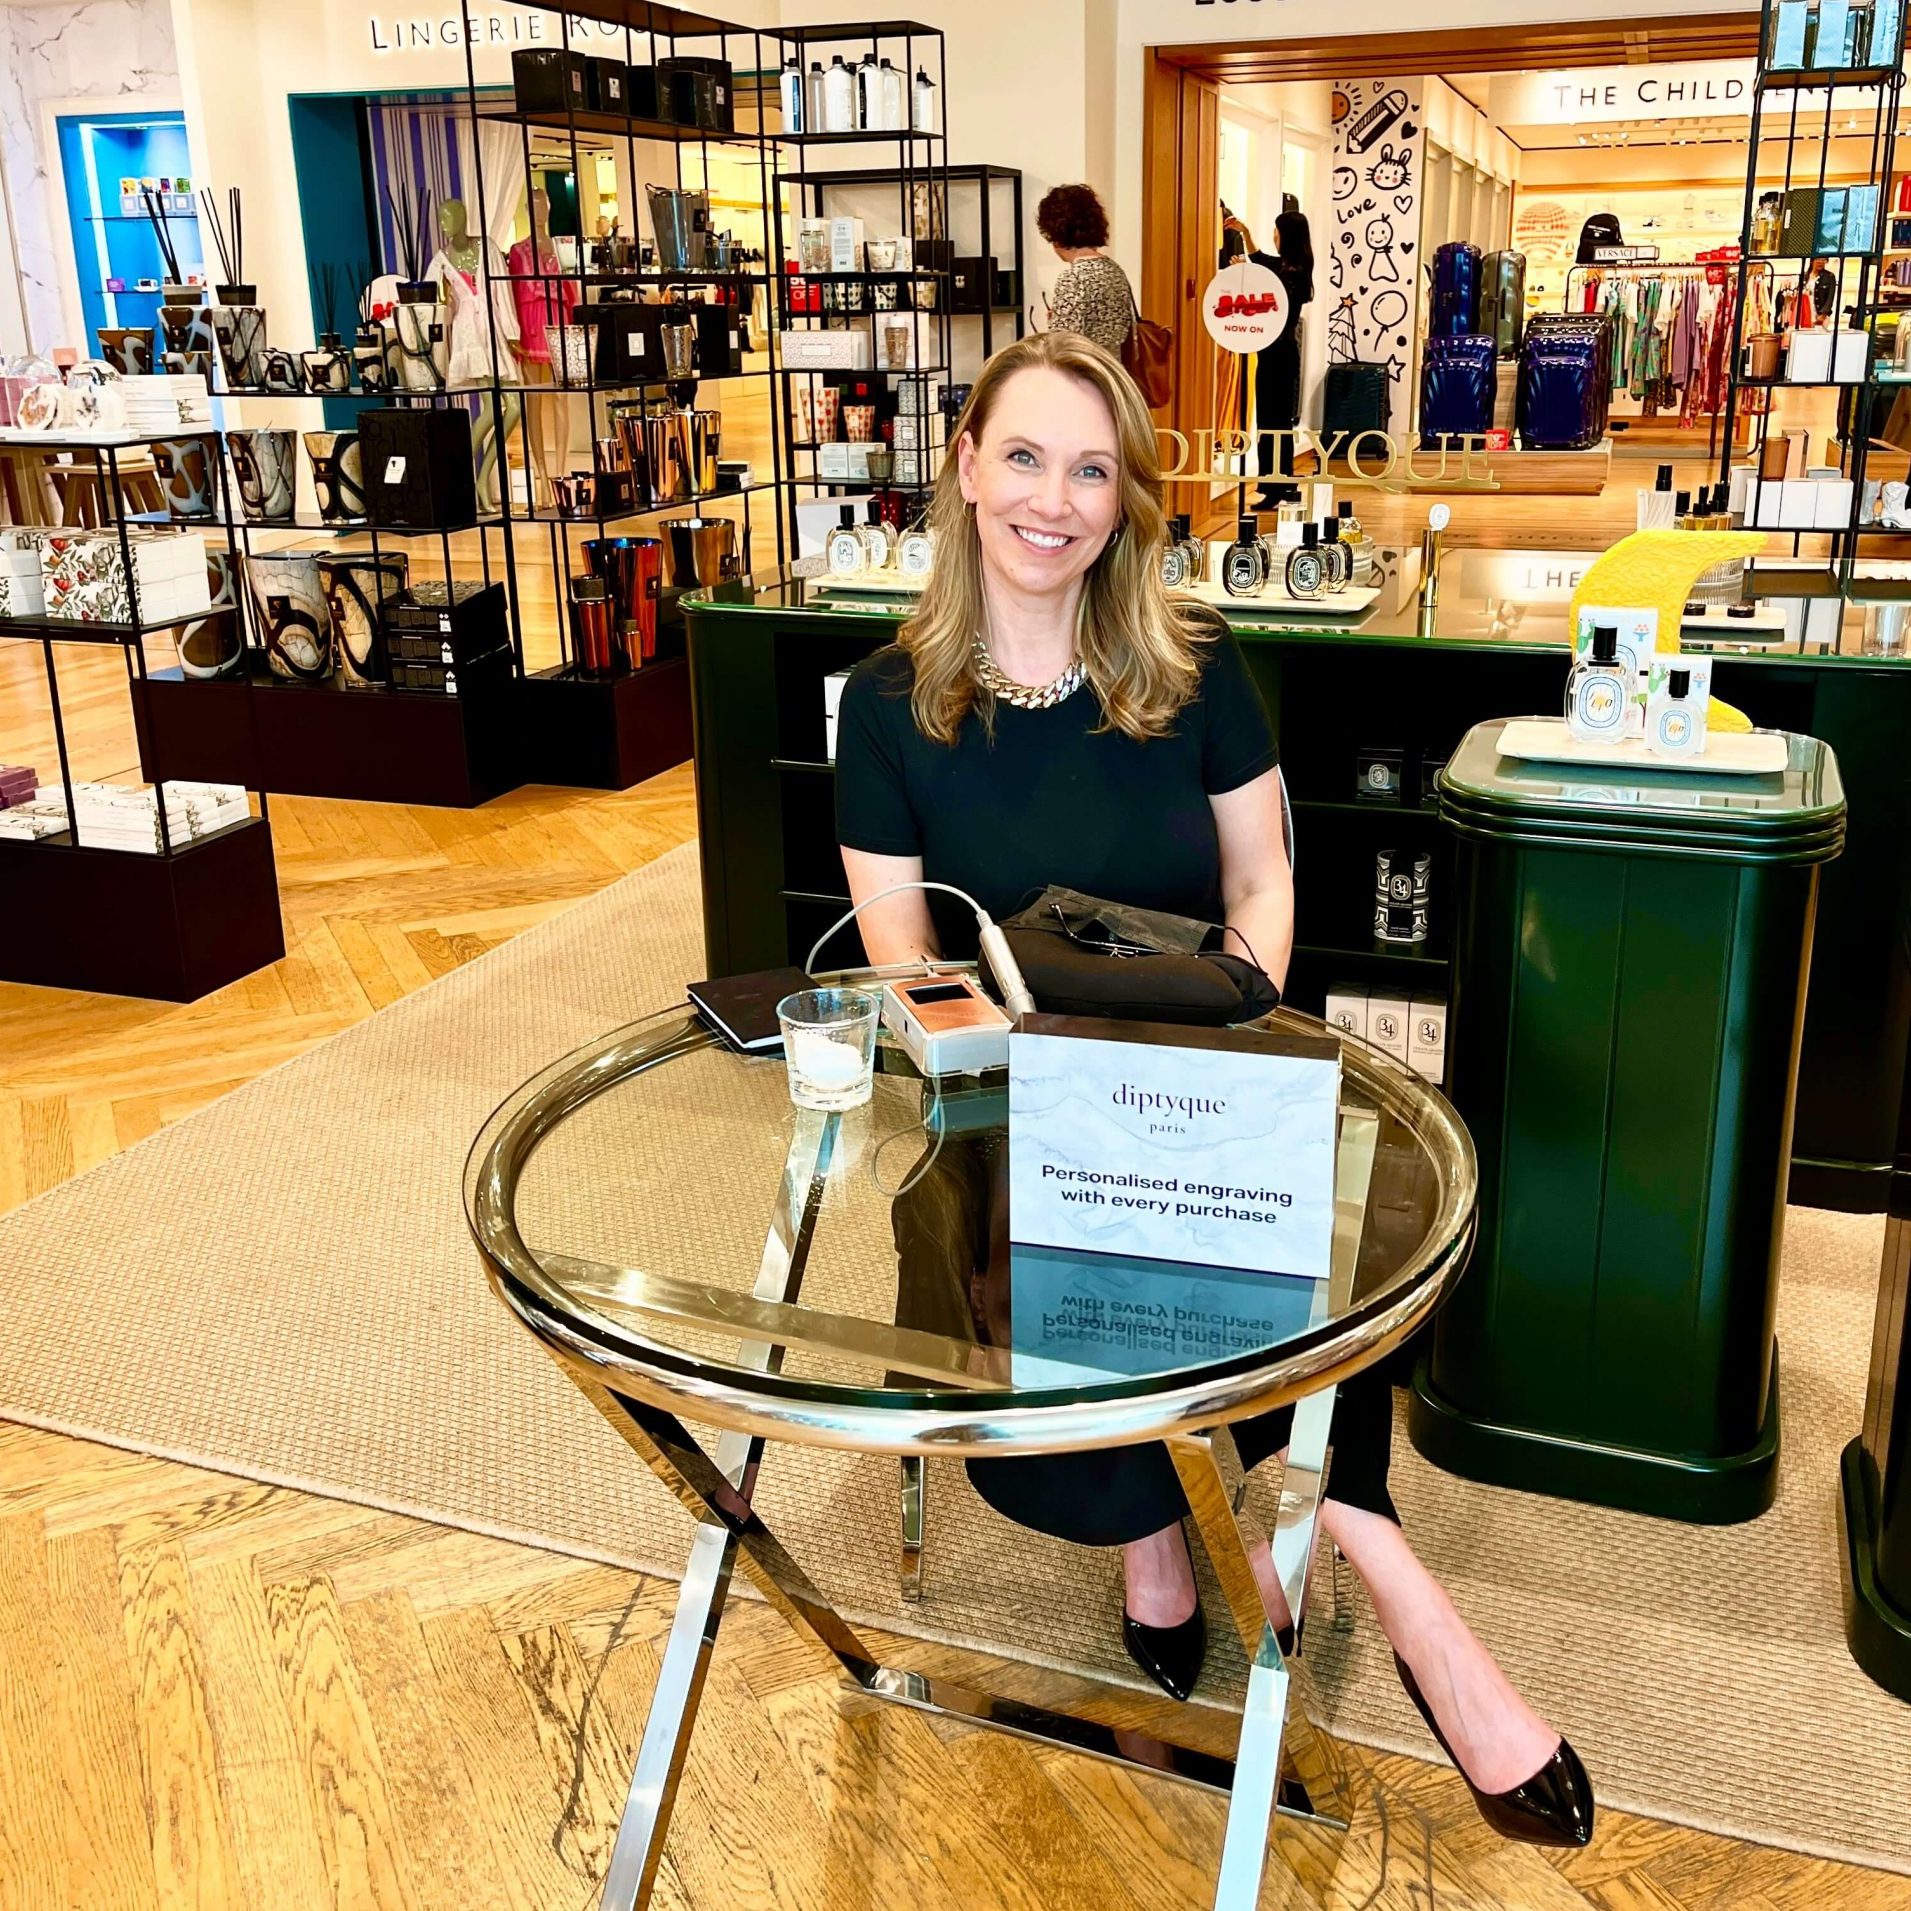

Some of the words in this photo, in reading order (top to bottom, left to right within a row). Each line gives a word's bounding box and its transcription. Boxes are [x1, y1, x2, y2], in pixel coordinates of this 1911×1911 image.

[371, 15, 542, 49] LINGERIE
[1554, 84, 1617, 108] THE
[1597, 248, 1635, 258] VERSACE
[1214, 292, 1278, 318] SALE
[1224, 325, 1247, 333] NOW
[1154, 428, 1495, 494] DIPTYQUE
[1394, 879, 1408, 897] 34
[1340, 1015, 1353, 1032] 34
[1380, 1018, 1395, 1038] 34
[1423, 1023, 1437, 1042] 34
[1112, 1083, 1226, 1119] diptyque
[1150, 1123, 1187, 1134] paris
[1042, 1164, 1178, 1192] Personalised
[1184, 1183, 1293, 1207] engraving
[1061, 1189, 1105, 1205] with
[1111, 1196, 1170, 1215] every
[1175, 1201, 1278, 1224] purchase
